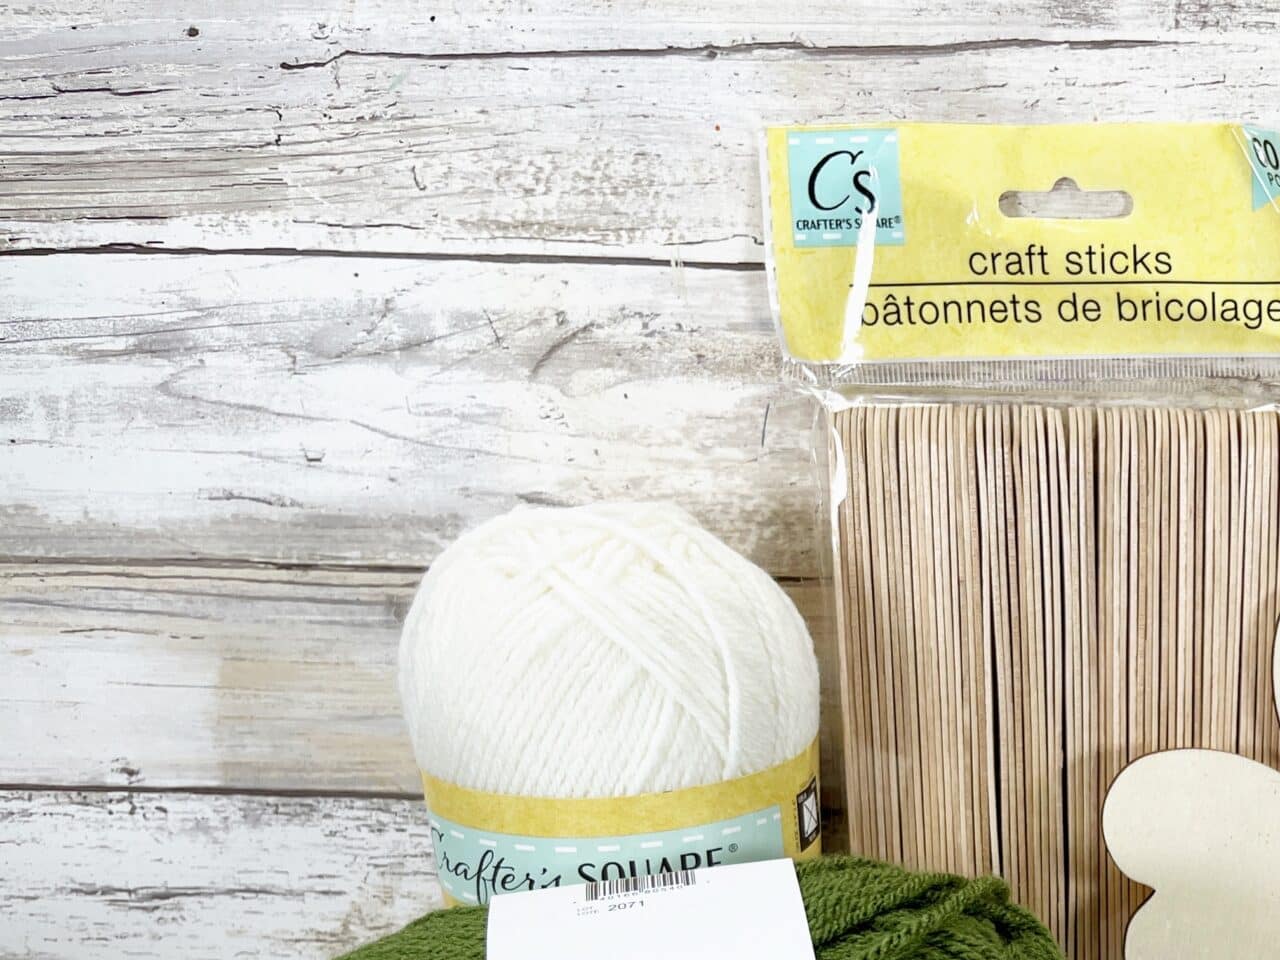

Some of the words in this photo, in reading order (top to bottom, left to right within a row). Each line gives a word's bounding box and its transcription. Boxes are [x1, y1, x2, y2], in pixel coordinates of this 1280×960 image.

[795, 217, 853, 231] CRAFTER'S
[854, 217, 895, 230] SARE
[968, 243, 1050, 276] craft
[1065, 244, 1173, 275] sticks
[1057, 292, 1102, 322] de
[431, 827, 562, 905] rafter's
[608, 900, 645, 912] 2071
